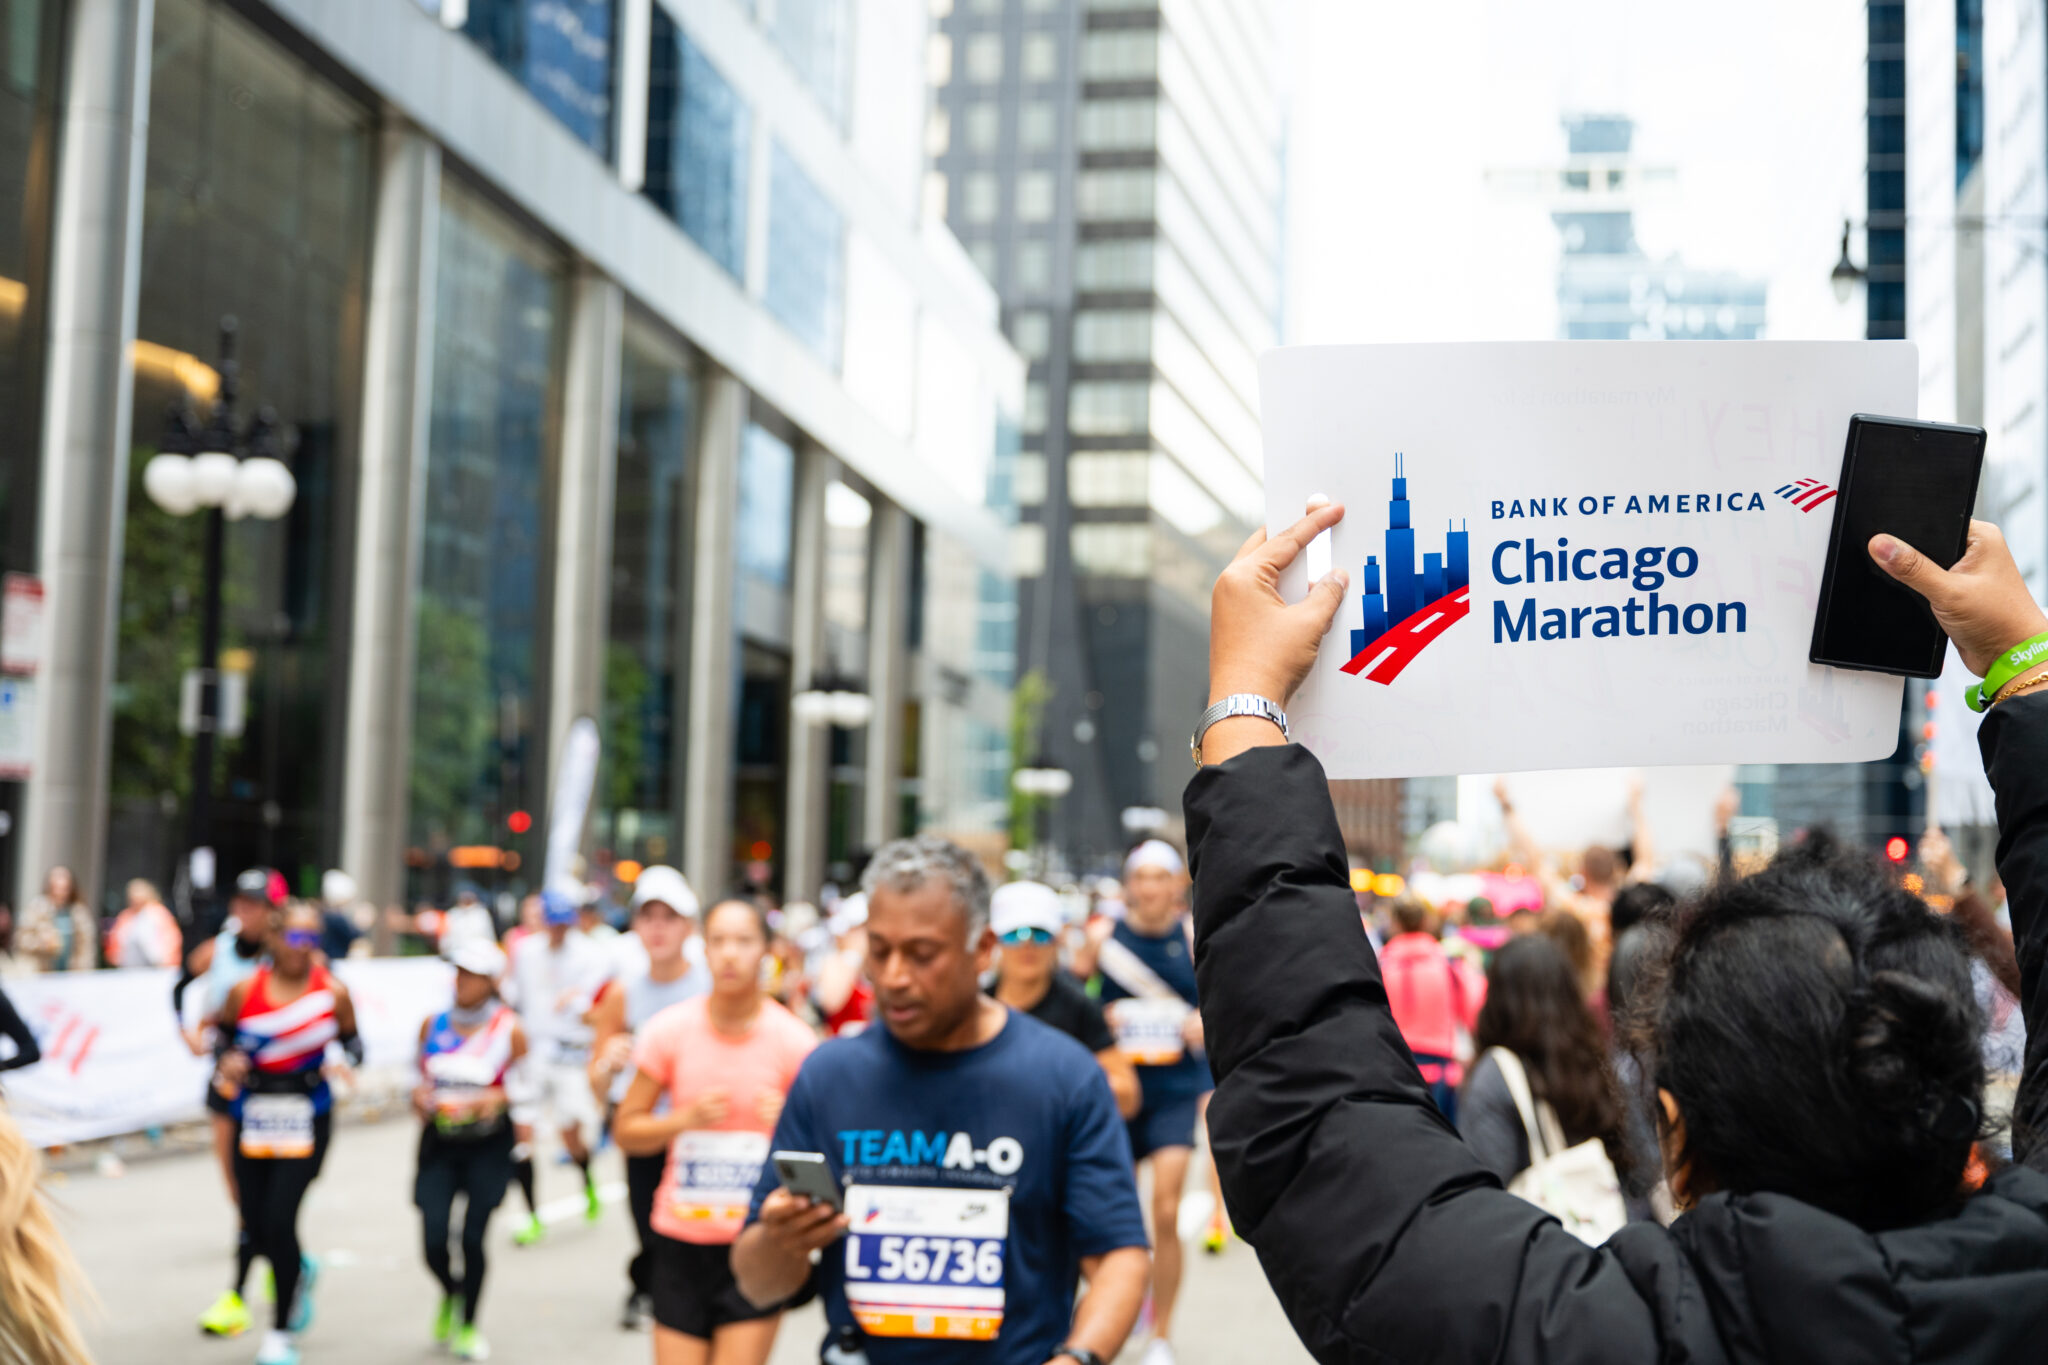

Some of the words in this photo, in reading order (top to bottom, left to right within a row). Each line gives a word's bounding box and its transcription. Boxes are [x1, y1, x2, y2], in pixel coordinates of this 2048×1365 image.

[1491, 497, 1569, 519] BANK
[1578, 496, 1616, 515] OF
[1624, 492, 1766, 514] AMERICA
[1491, 537, 1699, 592] Chicago
[1493, 592, 1747, 644] Marathon
[845, 1234, 872, 1280] L
[877, 1236, 1003, 1285] 56736
